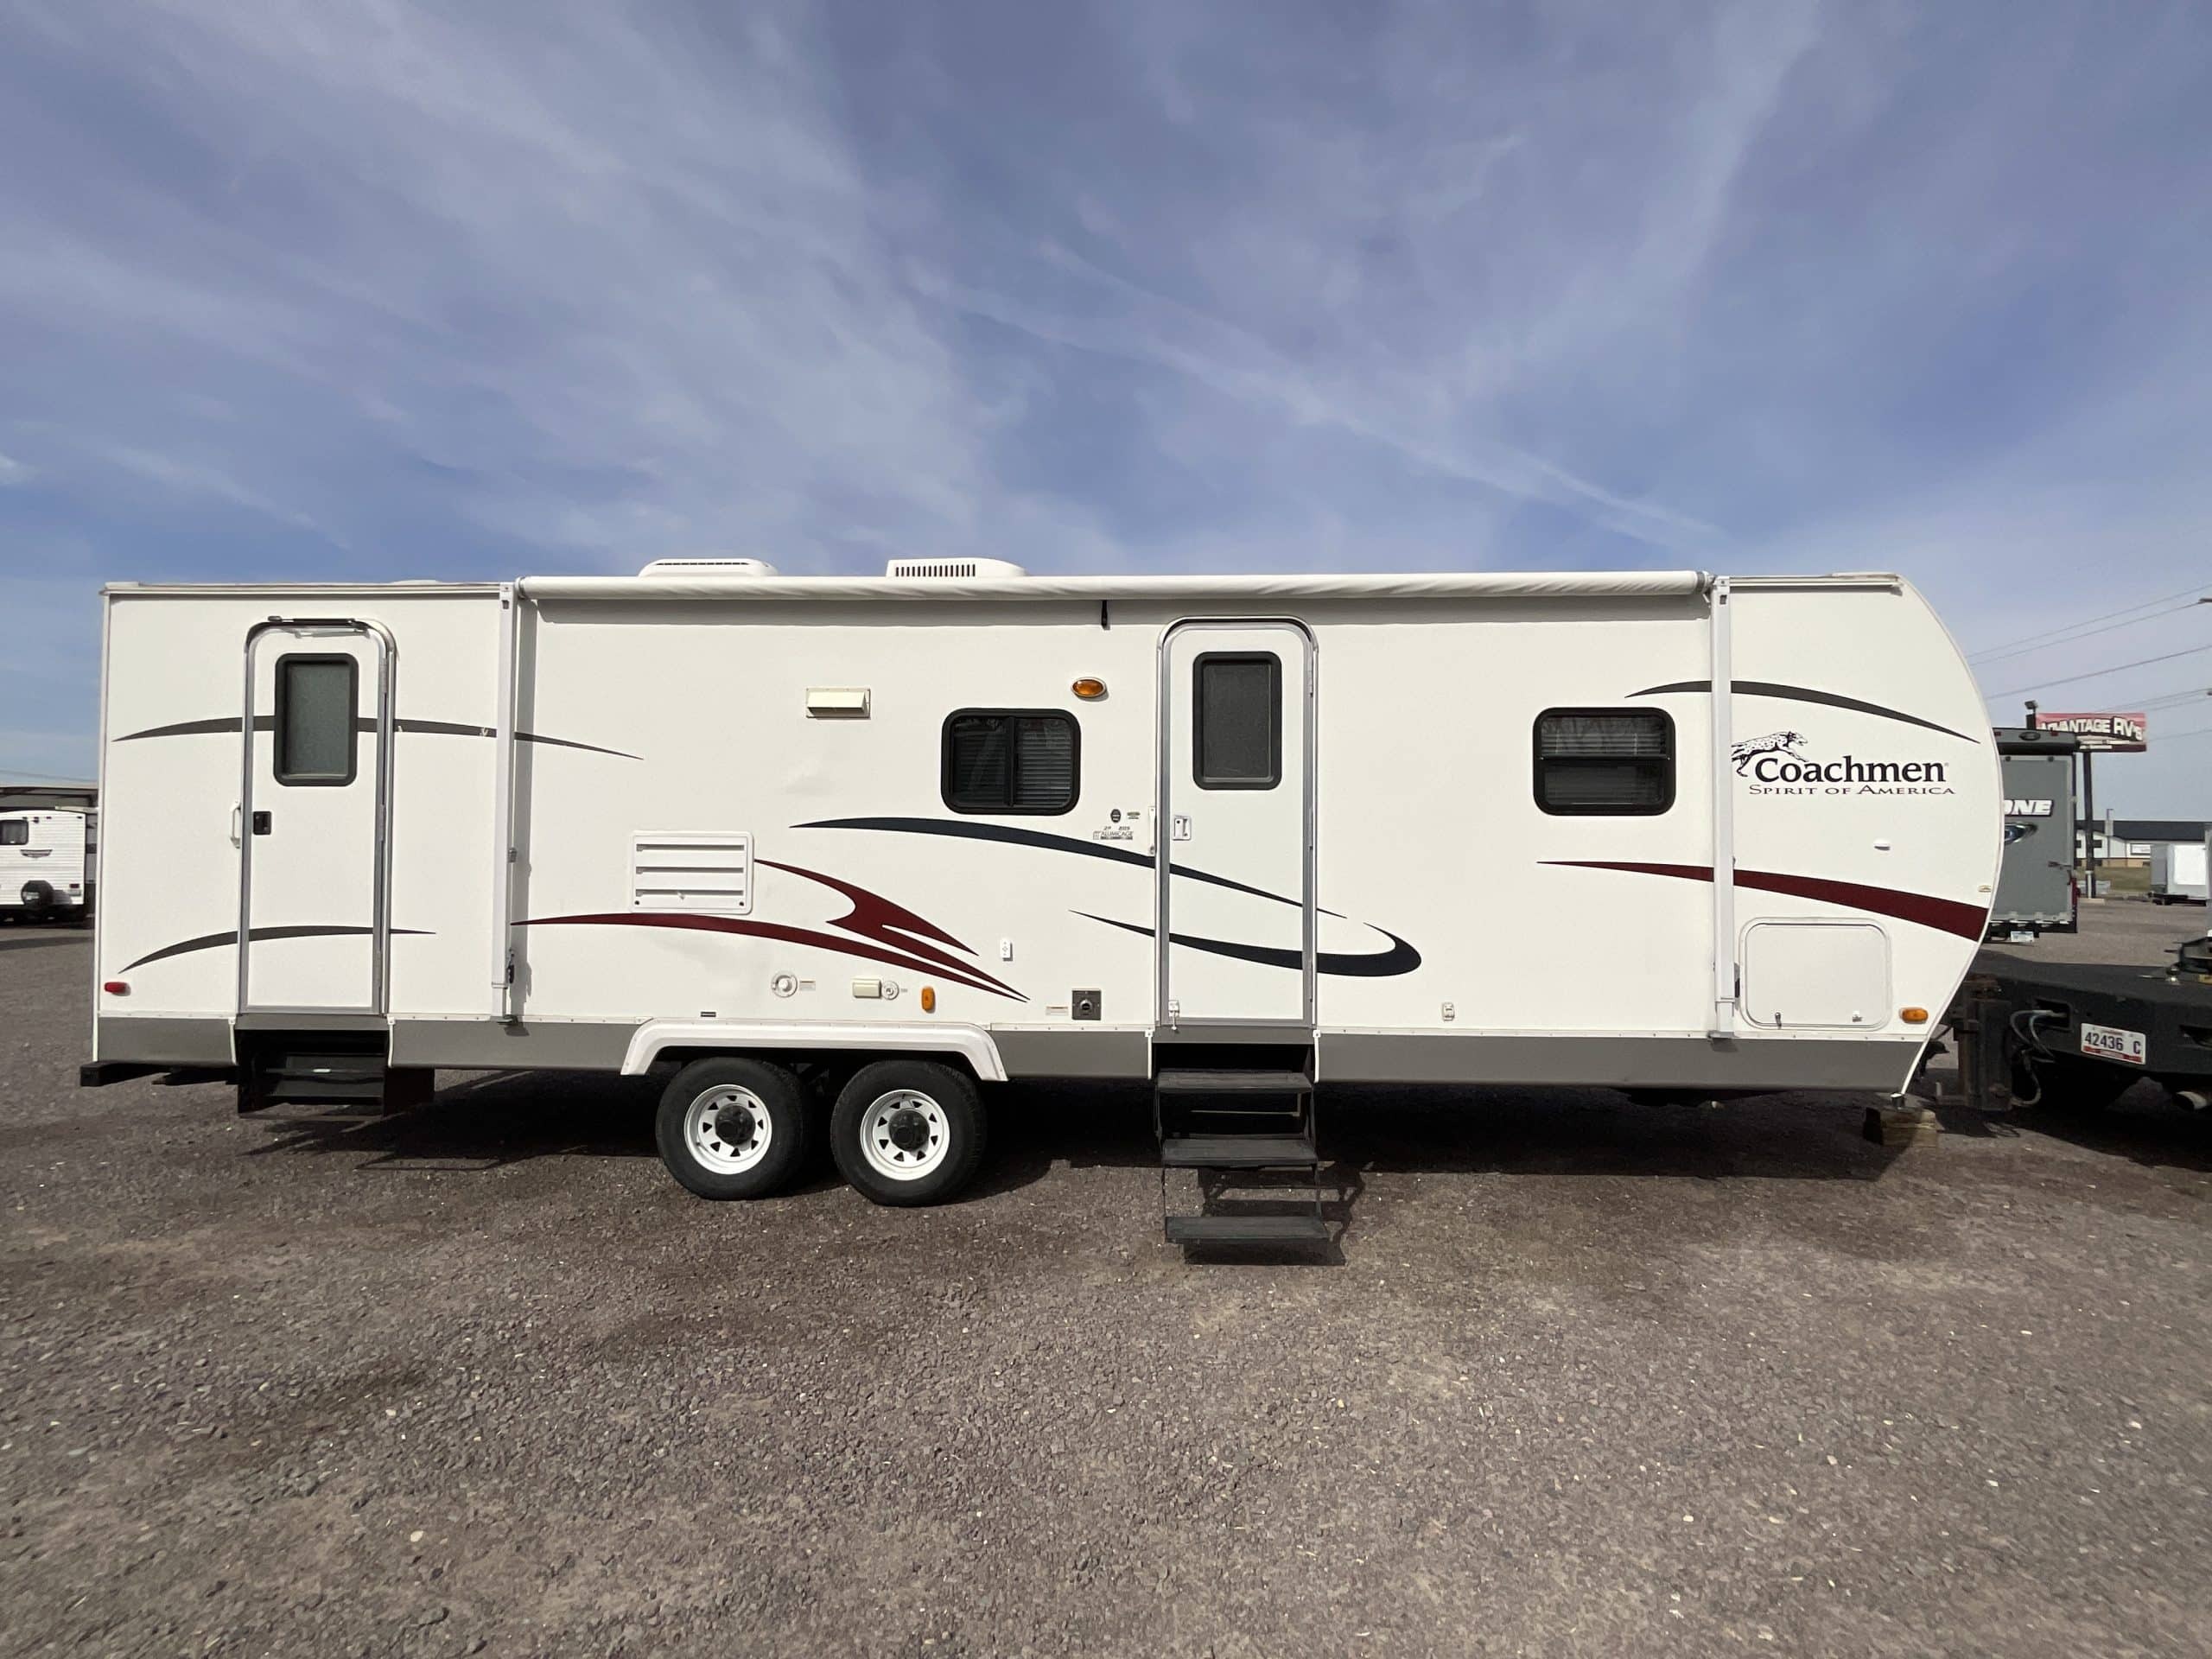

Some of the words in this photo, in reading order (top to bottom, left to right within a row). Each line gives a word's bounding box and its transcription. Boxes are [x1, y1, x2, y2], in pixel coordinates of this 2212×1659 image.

[1755, 755, 1947, 783] Coachmen
[1749, 785, 1817, 795] SPIRIT
[1858, 784, 1957, 795] AMERICA
[2085, 1032, 2123, 1052] 42436
[2133, 1040, 2141, 1054] C
